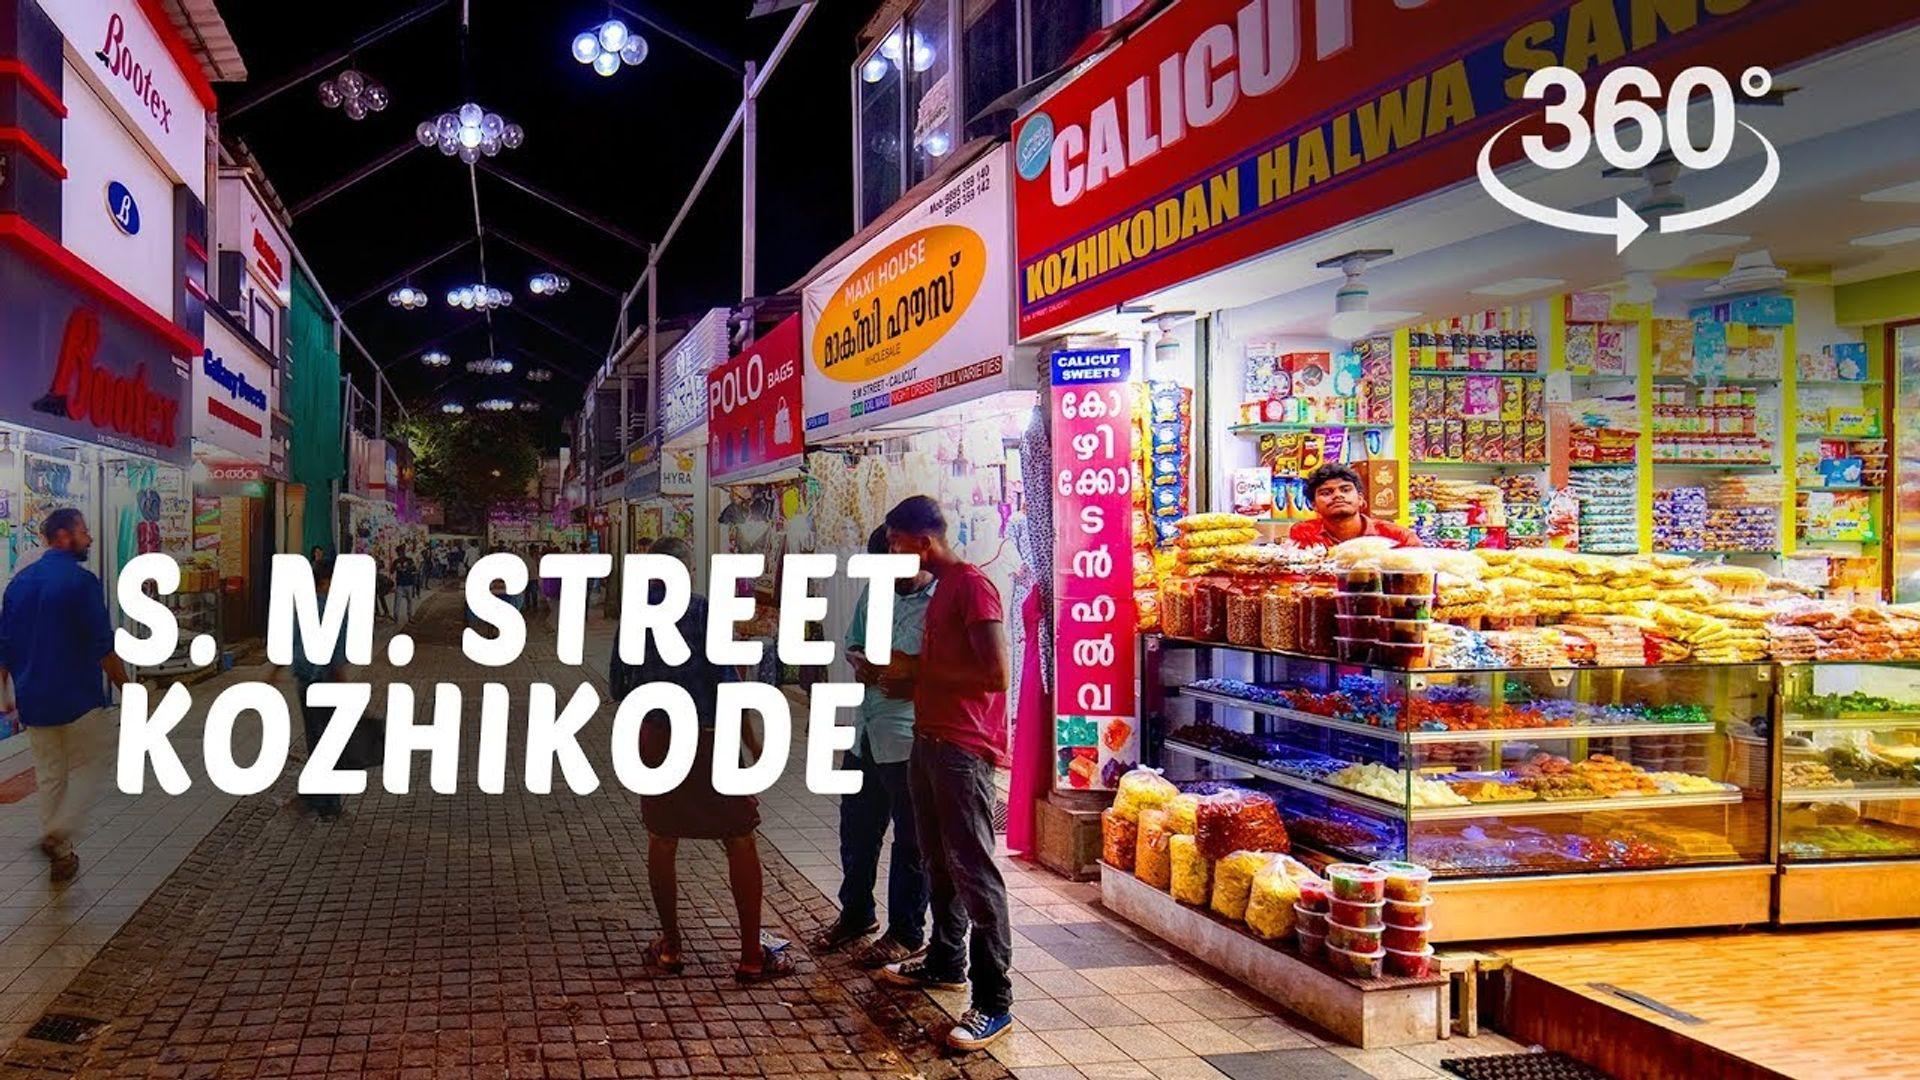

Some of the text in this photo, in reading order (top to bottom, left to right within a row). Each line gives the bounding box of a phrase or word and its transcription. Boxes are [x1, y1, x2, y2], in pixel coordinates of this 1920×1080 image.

[99, 13, 172, 133] Bootex
[1026, 0, 1752, 304] KOZHIKODAN HALWA SAN
[844, 237, 926, 307] MAXI HOUSE
[50, 306, 178, 448] Bootex
[863, 379, 885, 396] STREET
[889, 367, 918, 387] CALICUT
[943, 371, 957, 387] ALL
[957, 356, 1002, 382] VARIETIES
[1057, 354, 1120, 368] CALICUT
[1062, 367, 1121, 380] SWEETS
[709, 353, 763, 421] POLO
[767, 360, 794, 389] BAGS
[663, 472, 692, 485] HYRA
